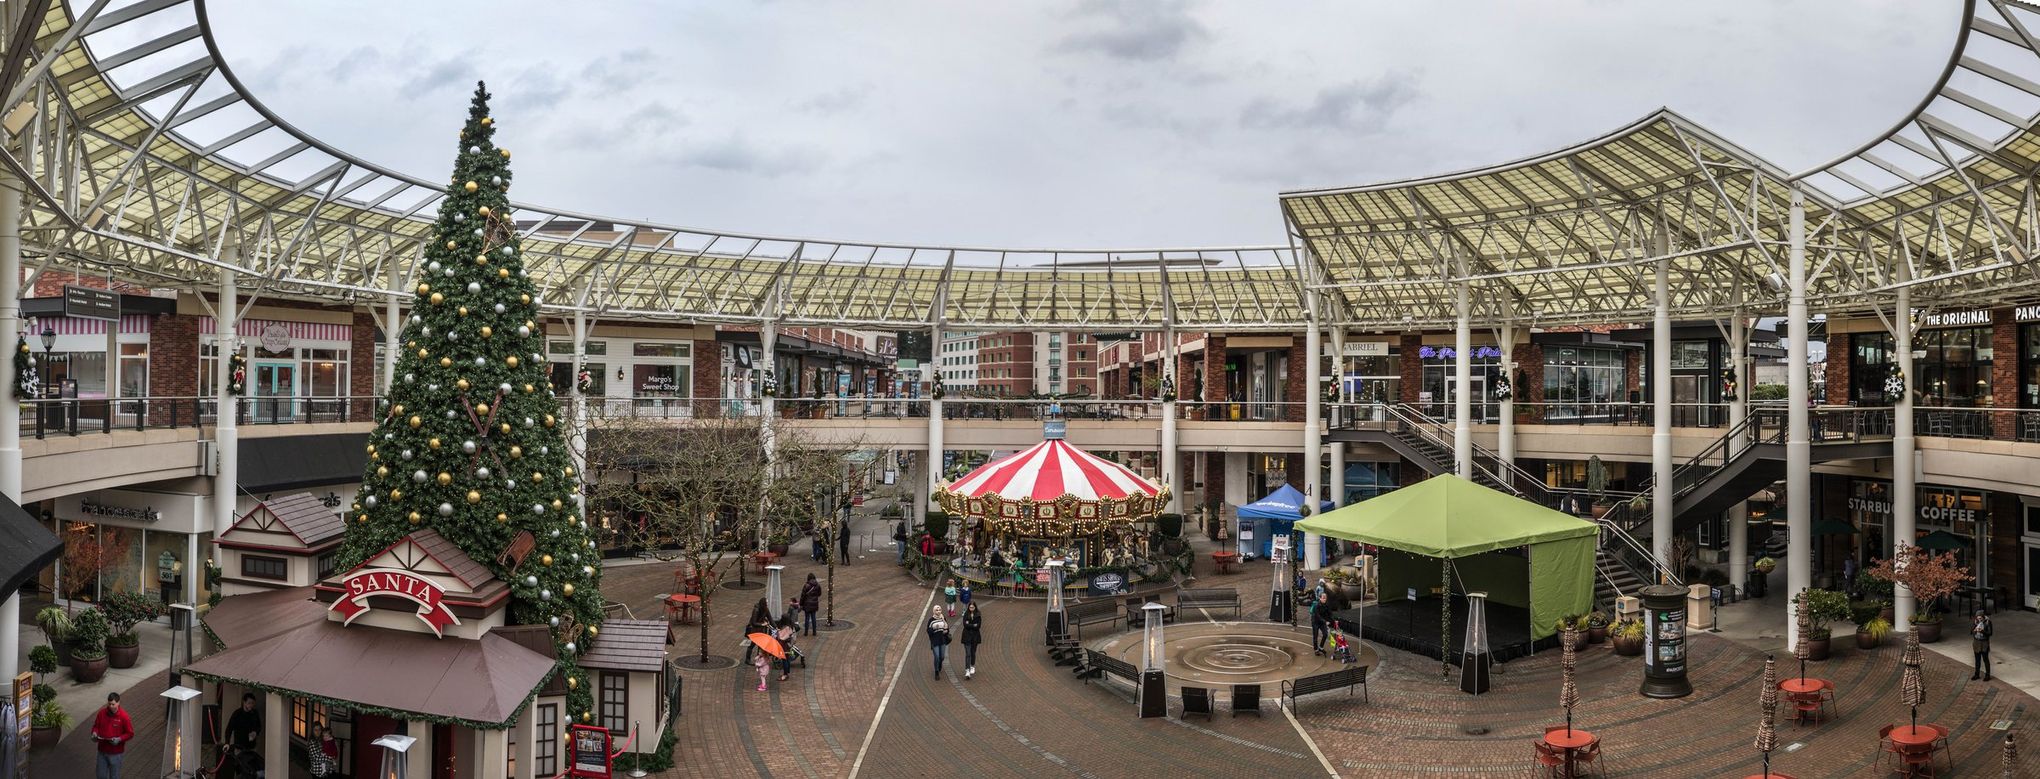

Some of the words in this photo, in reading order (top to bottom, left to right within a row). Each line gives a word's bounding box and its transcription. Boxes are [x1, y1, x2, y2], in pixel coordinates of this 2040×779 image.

[1927, 314, 1940, 326] THE
[1943, 309, 1990, 326] ORIGINAL
[648, 375, 672, 384] Margo's
[663, 383, 680, 391] Shop
[1848, 498, 1896, 515] STARBU
[1921, 506, 1975, 522] COFFEE
[350, 573, 431, 604] SANTA
